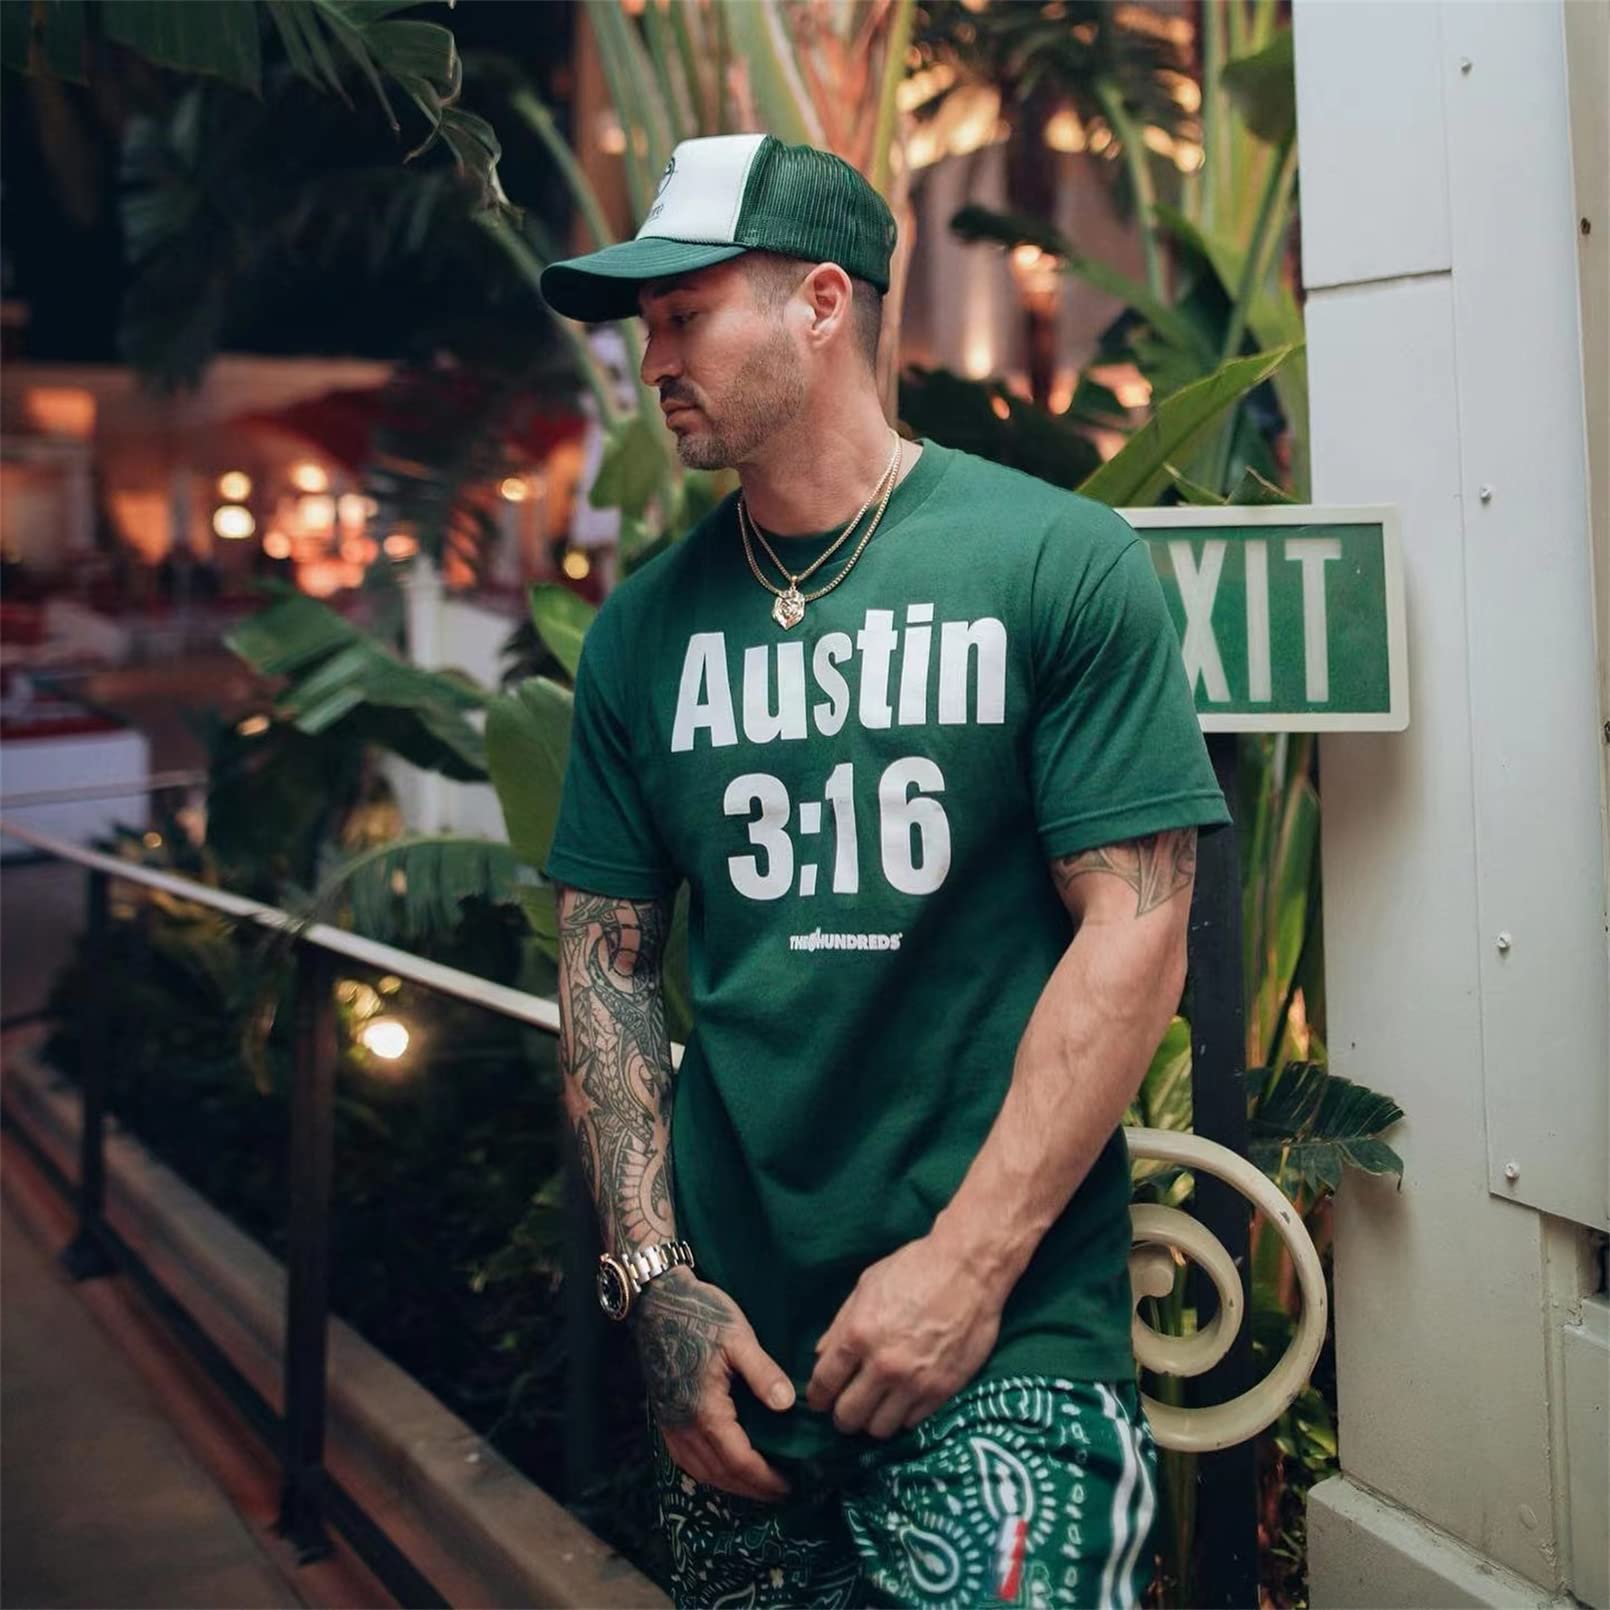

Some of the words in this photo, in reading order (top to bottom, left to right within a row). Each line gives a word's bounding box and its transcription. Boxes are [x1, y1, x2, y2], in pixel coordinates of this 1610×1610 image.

[671, 602, 1007, 752] Austin
[1166, 537, 1342, 703] XIT
[723, 756, 951, 900] 3:16
[816, 933, 901, 950] HUNDREDS
